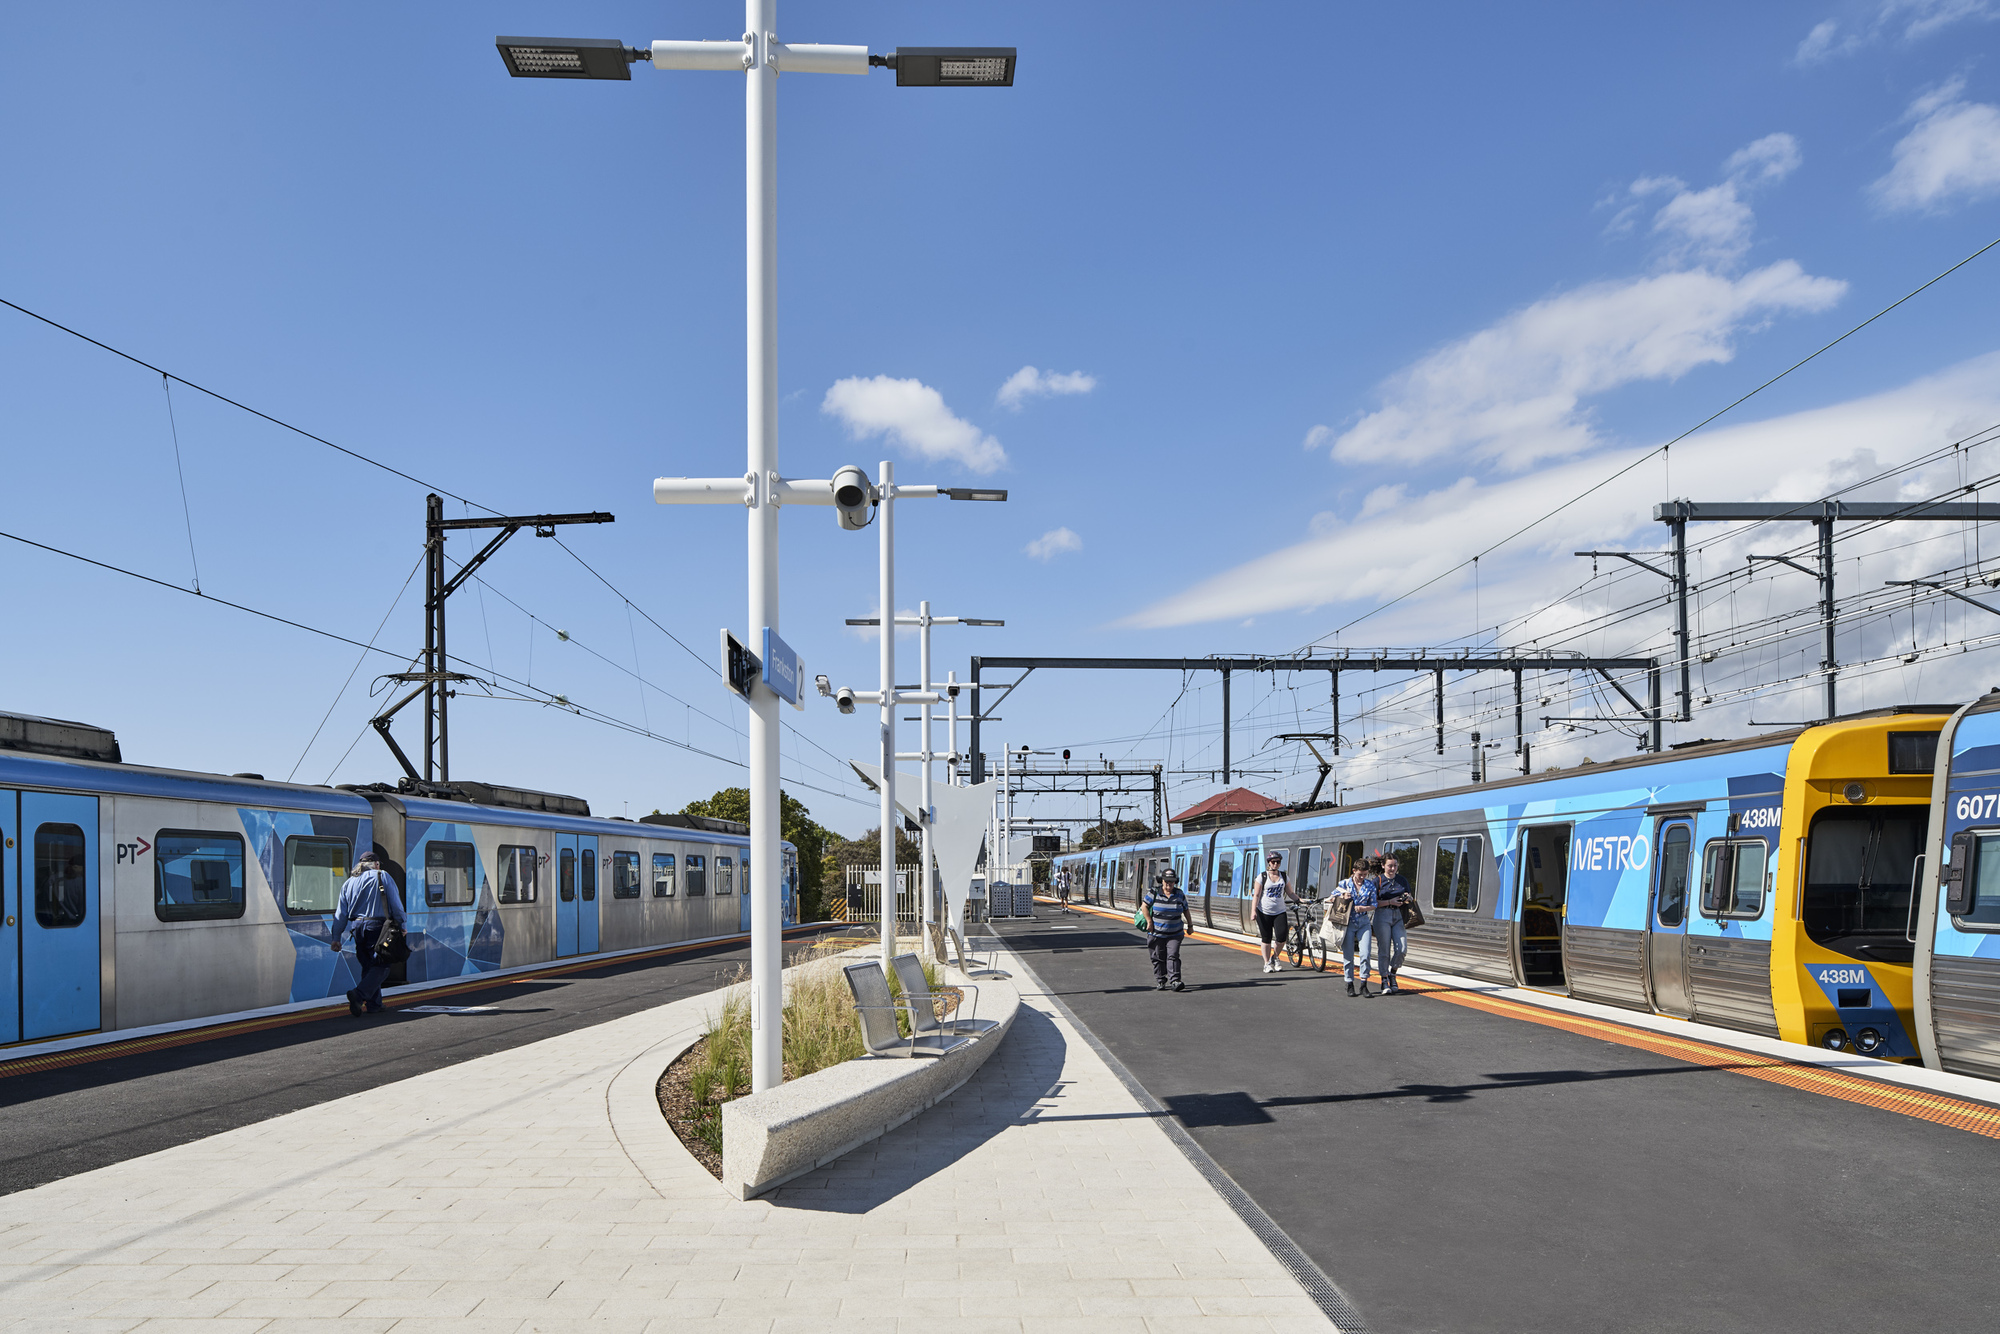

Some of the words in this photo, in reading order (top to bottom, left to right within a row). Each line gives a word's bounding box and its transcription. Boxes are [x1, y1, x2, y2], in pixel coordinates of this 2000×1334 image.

[798, 664, 804, 701] 2
[1741, 807, 1782, 828] 438M
[1956, 794, 2000, 820] 607
[1573, 834, 1650, 871] METRO
[1819, 969, 1865, 984] 438M
